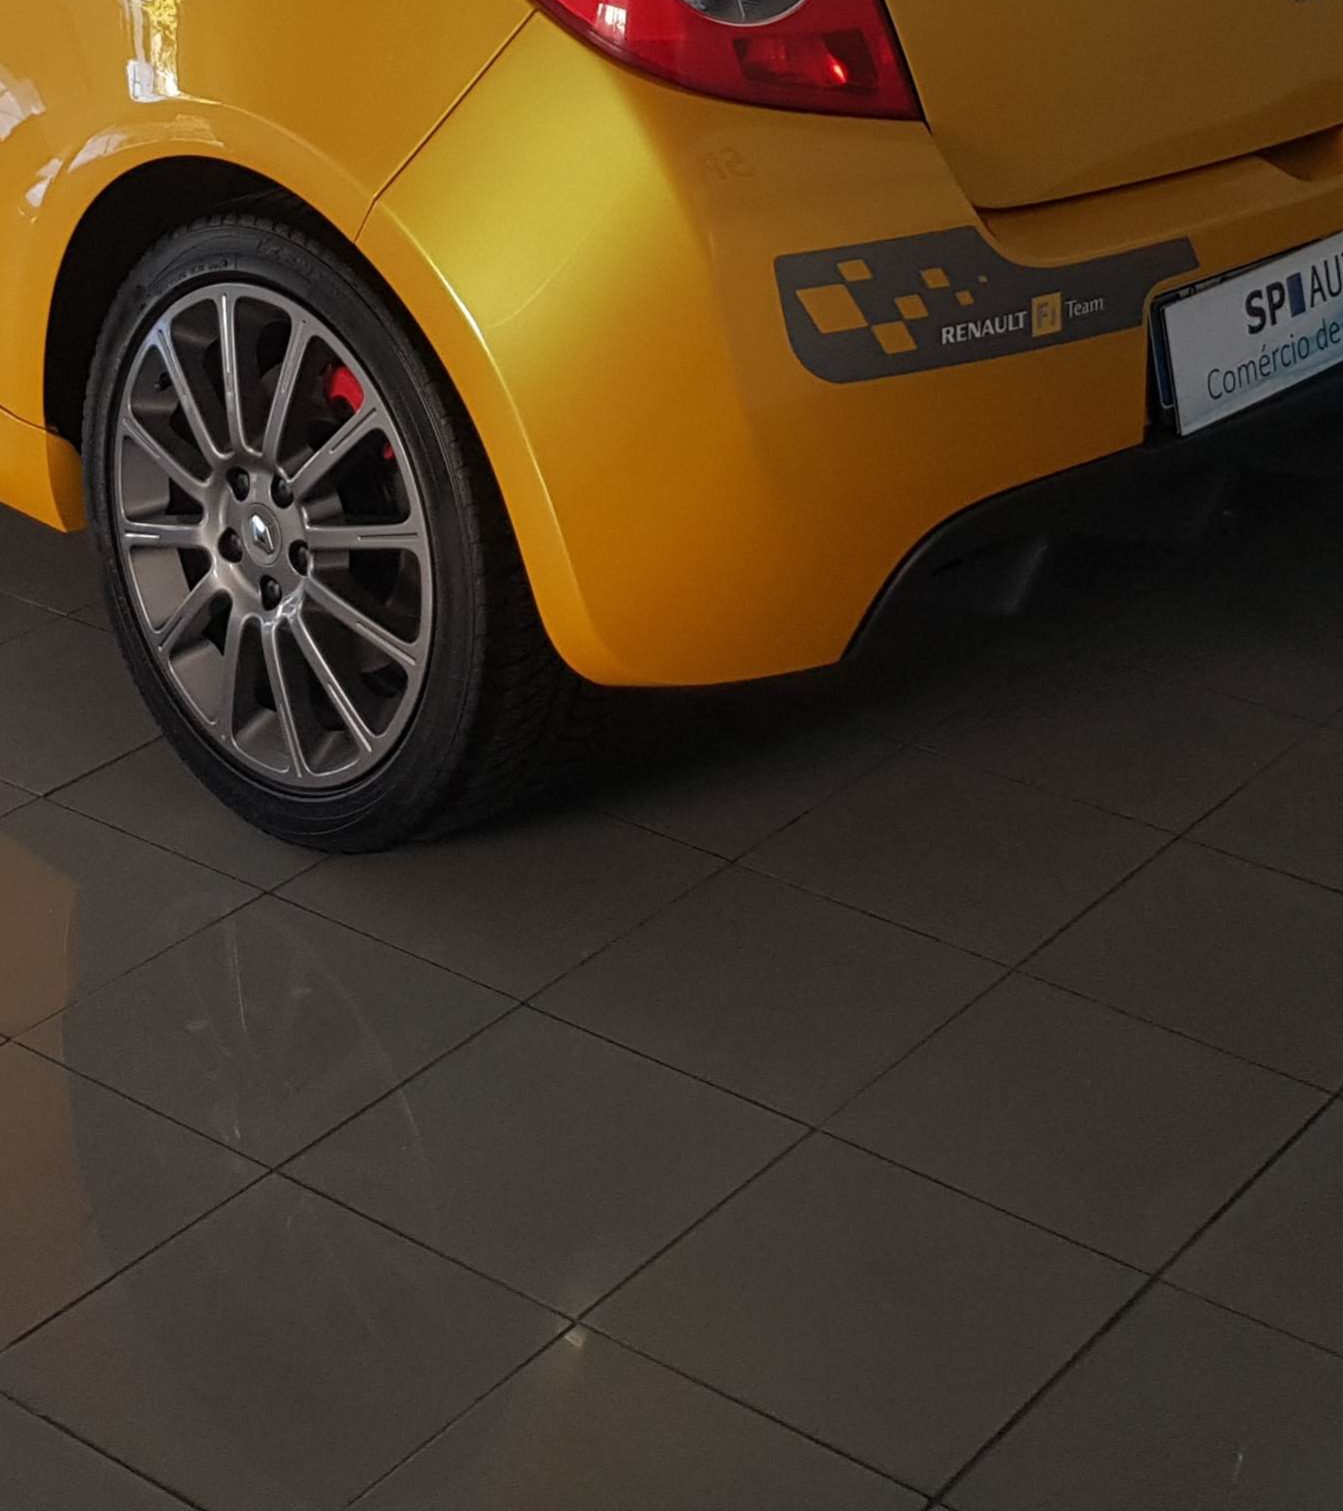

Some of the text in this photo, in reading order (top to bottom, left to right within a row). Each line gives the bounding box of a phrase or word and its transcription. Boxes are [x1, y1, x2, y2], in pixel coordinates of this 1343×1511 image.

[940, 310, 1028, 345] RENAULT
[1064, 296, 1105, 319] Team
[1244, 281, 1286, 336] SP
[1206, 333, 1311, 401] Comércio
[1315, 318, 1342, 351] de
